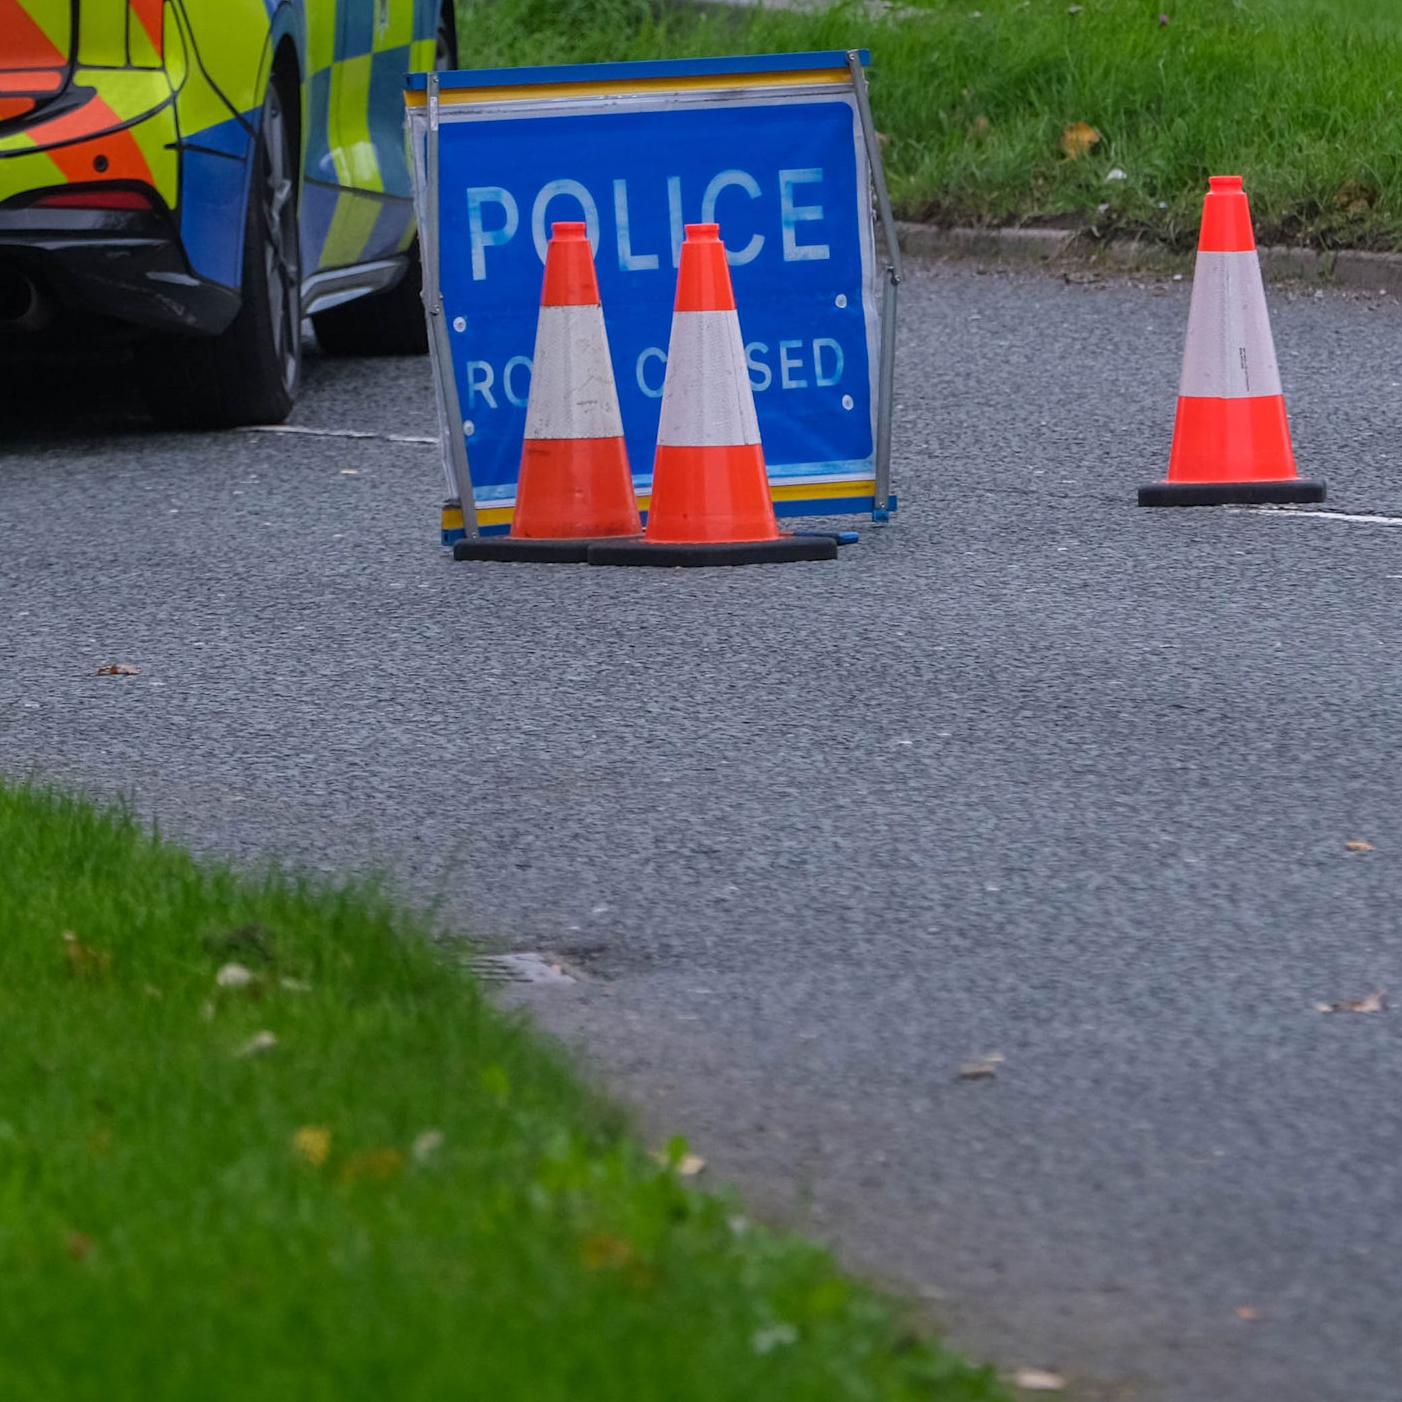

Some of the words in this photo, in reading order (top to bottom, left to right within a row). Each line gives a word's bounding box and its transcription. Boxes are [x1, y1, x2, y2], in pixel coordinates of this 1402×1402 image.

[466, 167, 830, 281] POLICE
[467, 355, 534, 410] RO
[635, 337, 844, 398] CSED
